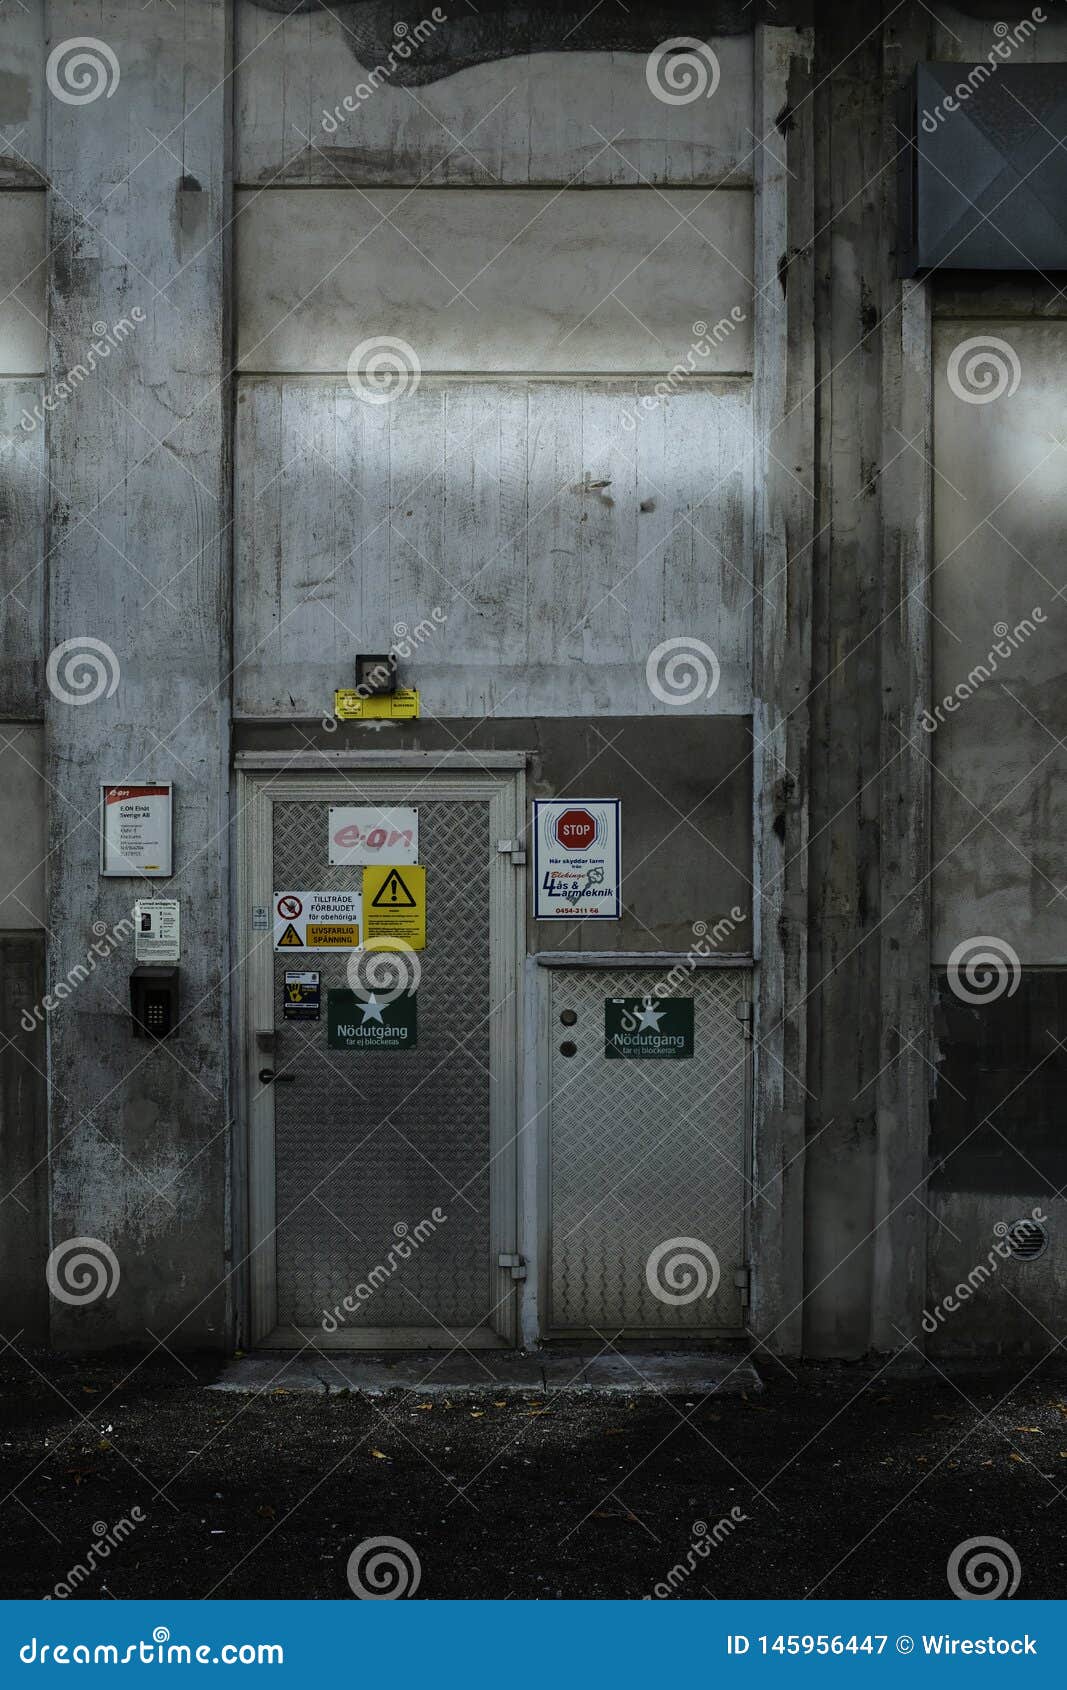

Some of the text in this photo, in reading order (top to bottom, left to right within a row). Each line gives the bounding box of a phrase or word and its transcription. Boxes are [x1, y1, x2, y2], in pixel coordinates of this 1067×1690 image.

[563, 824, 591, 836] STOP
[551, 871, 586, 880] Blekinge
[571, 881, 579, 890] &
[311, 904, 355, 912] FÖRBJUDET
[308, 913, 319, 921] för
[320, 913, 357, 922] obehöriga
[311, 927, 354, 935] LIVSFARLIG
[337, 1024, 408, 1039] Nödutgång
[356, 1038, 364, 1048] ej
[365, 1038, 400, 1046] blockeras
